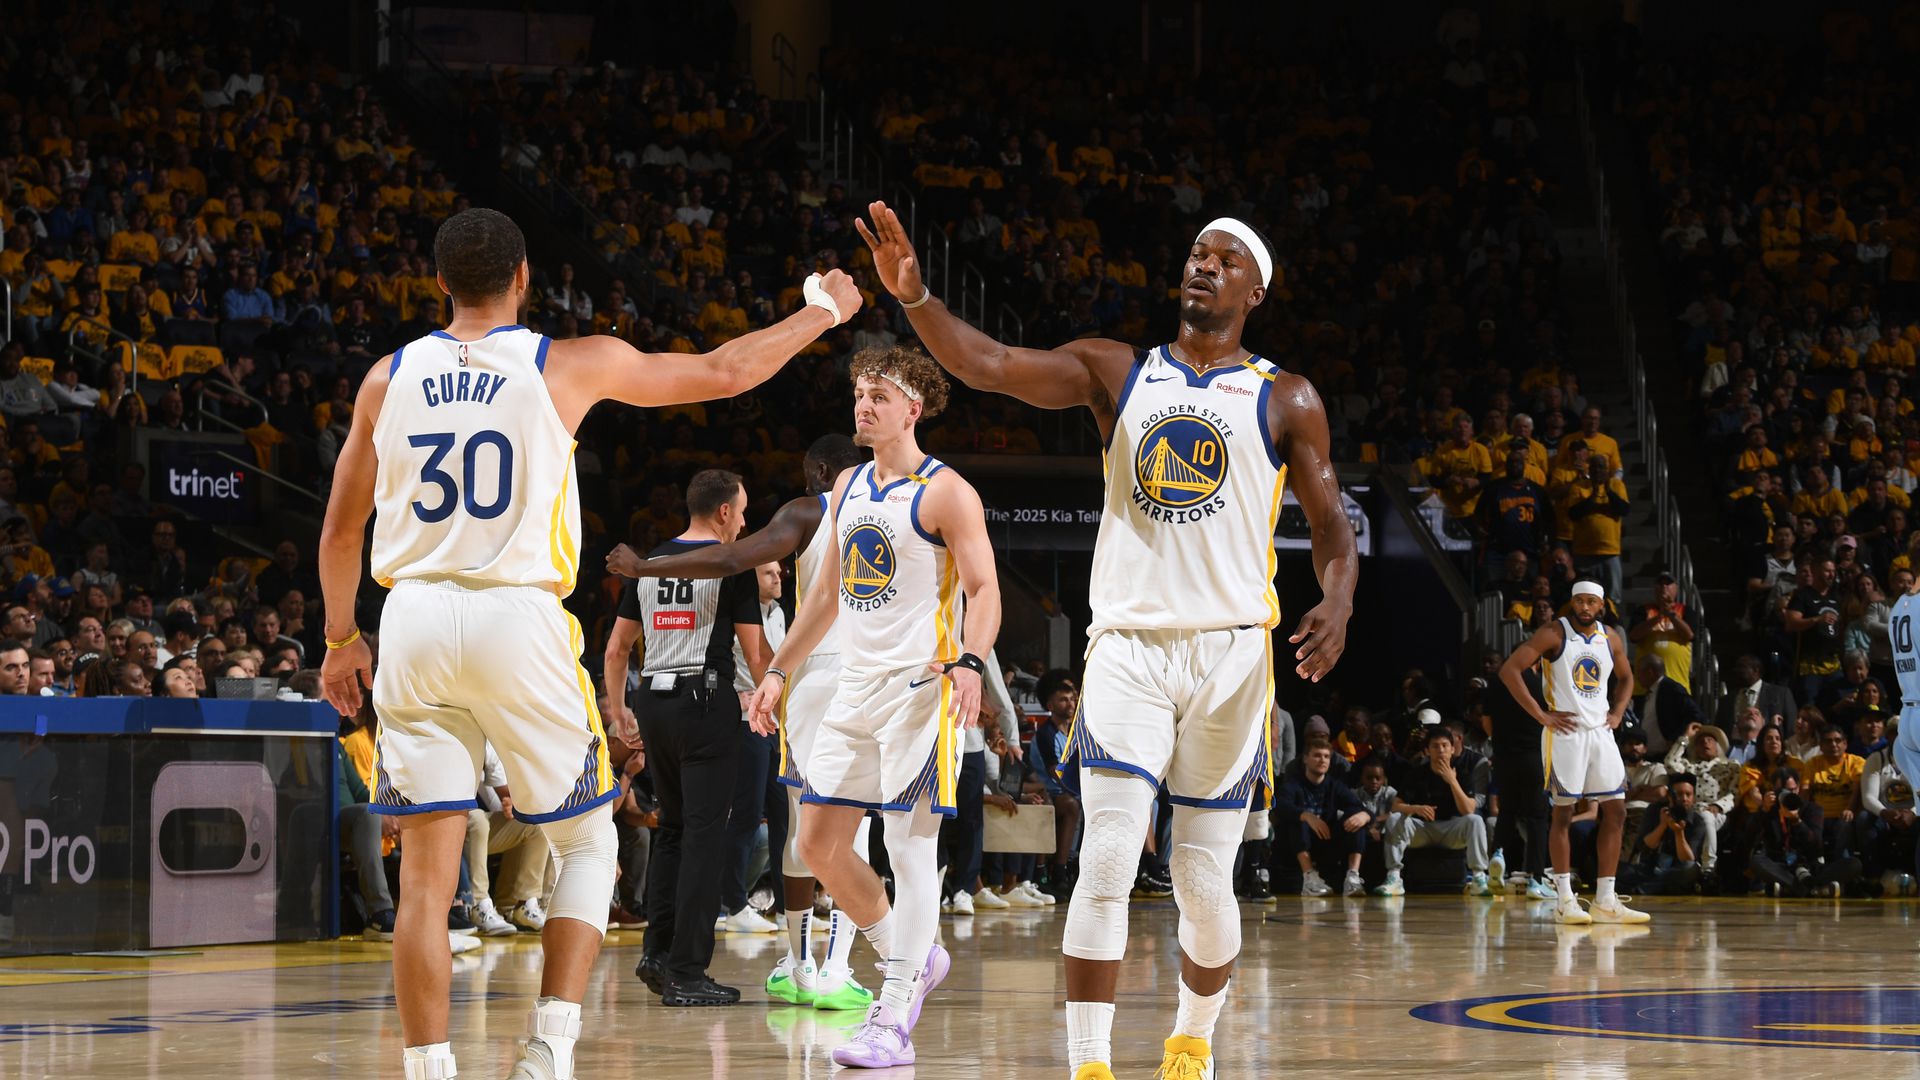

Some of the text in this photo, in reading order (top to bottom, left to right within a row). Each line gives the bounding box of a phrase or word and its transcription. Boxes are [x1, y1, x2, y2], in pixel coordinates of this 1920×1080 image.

[422, 371, 507, 408] CURRY
[1216, 382, 1254, 398] Rakuten
[1141, 404, 1234, 439] GOLDEN STATE
[1192, 439, 1216, 466] 10
[169, 468, 239, 499] trinet
[407, 430, 513, 523] 30
[985, 509, 1010, 521] The
[1013, 508, 1048, 522] 2025
[1051, 510, 1072, 523] Kia
[1131, 485, 1226, 524] WARRIORS
[842, 515, 897, 541] GOLDEN STATE
[874, 543, 885, 565] 2
[656, 615, 691, 625] Emirates
[1892, 614, 1913, 653] 10
[24, 818, 96, 885] Pro
